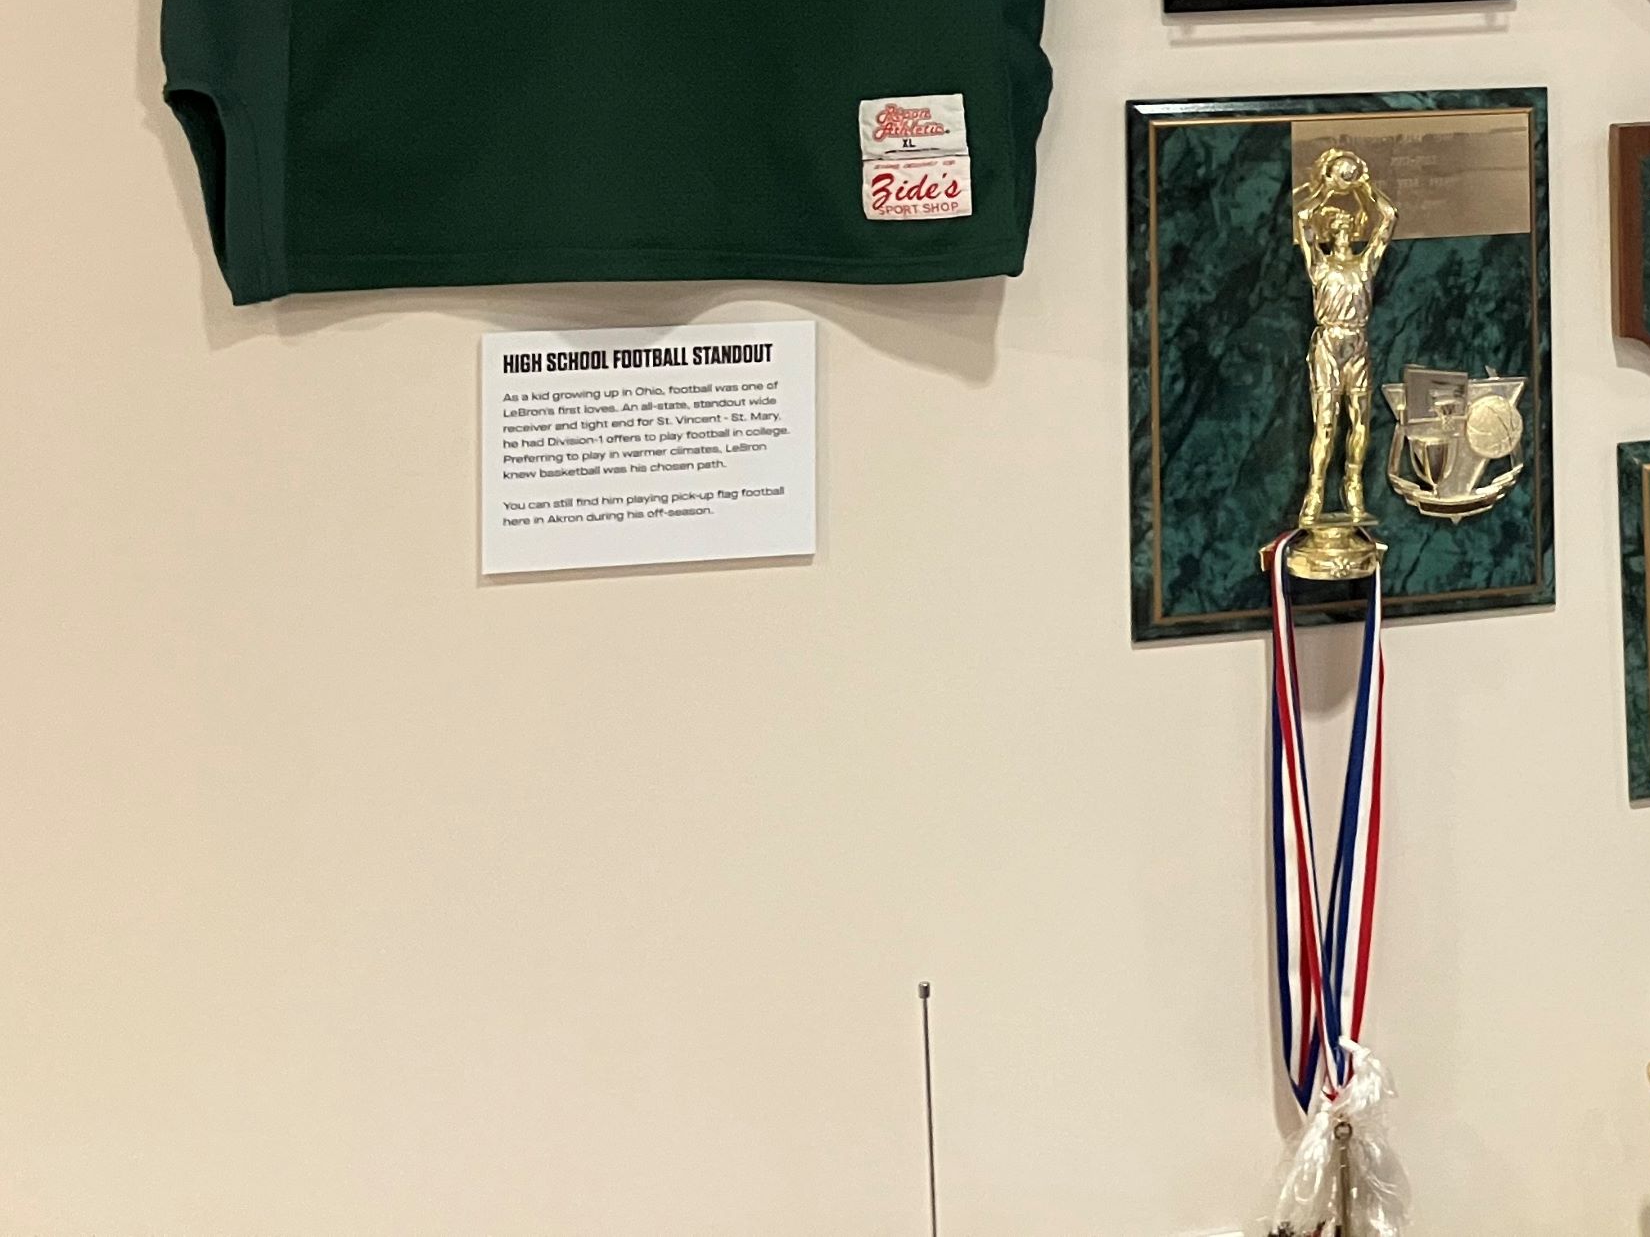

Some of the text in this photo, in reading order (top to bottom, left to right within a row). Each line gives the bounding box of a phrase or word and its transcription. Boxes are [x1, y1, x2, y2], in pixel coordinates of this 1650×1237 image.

[902, 139, 916, 148] XL
[872, 173, 962, 211] Zide's
[879, 202, 958, 216] SPORT SHOP
[503, 344, 773, 373] HIGH SCHOOL FOOTBALL STANDOUT
[552, 390, 600, 402] growing
[669, 384, 713, 394] football
[503, 408, 555, 418] LeBron's
[559, 406, 581, 415] first
[693, 398, 745, 409] standout
[503, 414, 721, 433] receiver tight Vincent
[606, 434, 641, 443] offers
[687, 429, 730, 439] football
[503, 443, 767, 464] Preferring warmer LeBron
[539, 462, 694, 478] basketball chosen
[553, 486, 785, 508] still playing pick-up football
[547, 512, 624, 523] Akron during
